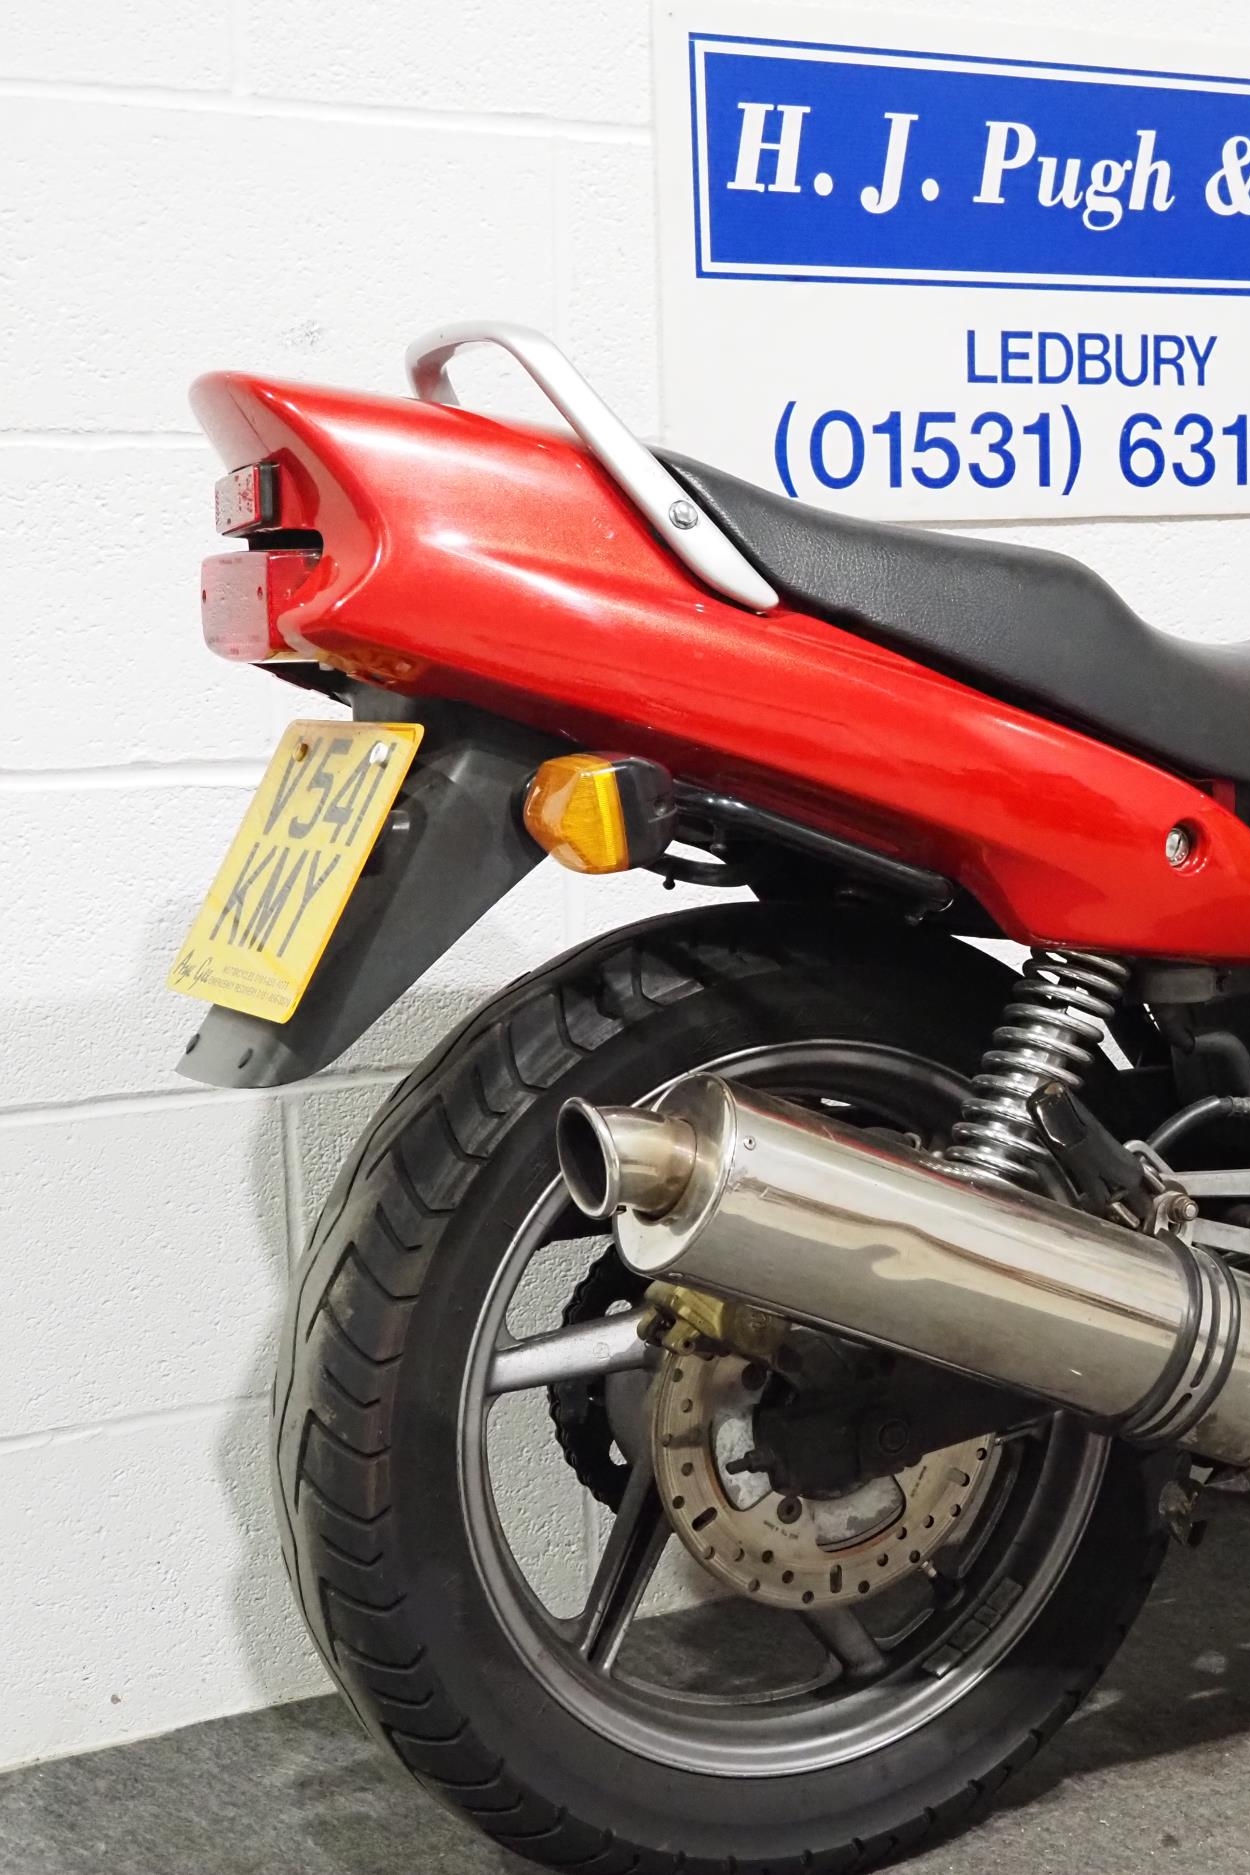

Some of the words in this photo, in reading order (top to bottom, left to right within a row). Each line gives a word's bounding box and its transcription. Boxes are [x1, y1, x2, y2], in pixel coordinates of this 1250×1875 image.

[727, 103, 833, 197] H.
[861, 113, 940, 214] J.
[973, 121, 1175, 231] Pugh
[967, 330, 1217, 386] LEDBURY
[774, 401, 1082, 498] (01531)
[262, 735, 397, 847] V541
[209, 842, 341, 958] KMY
